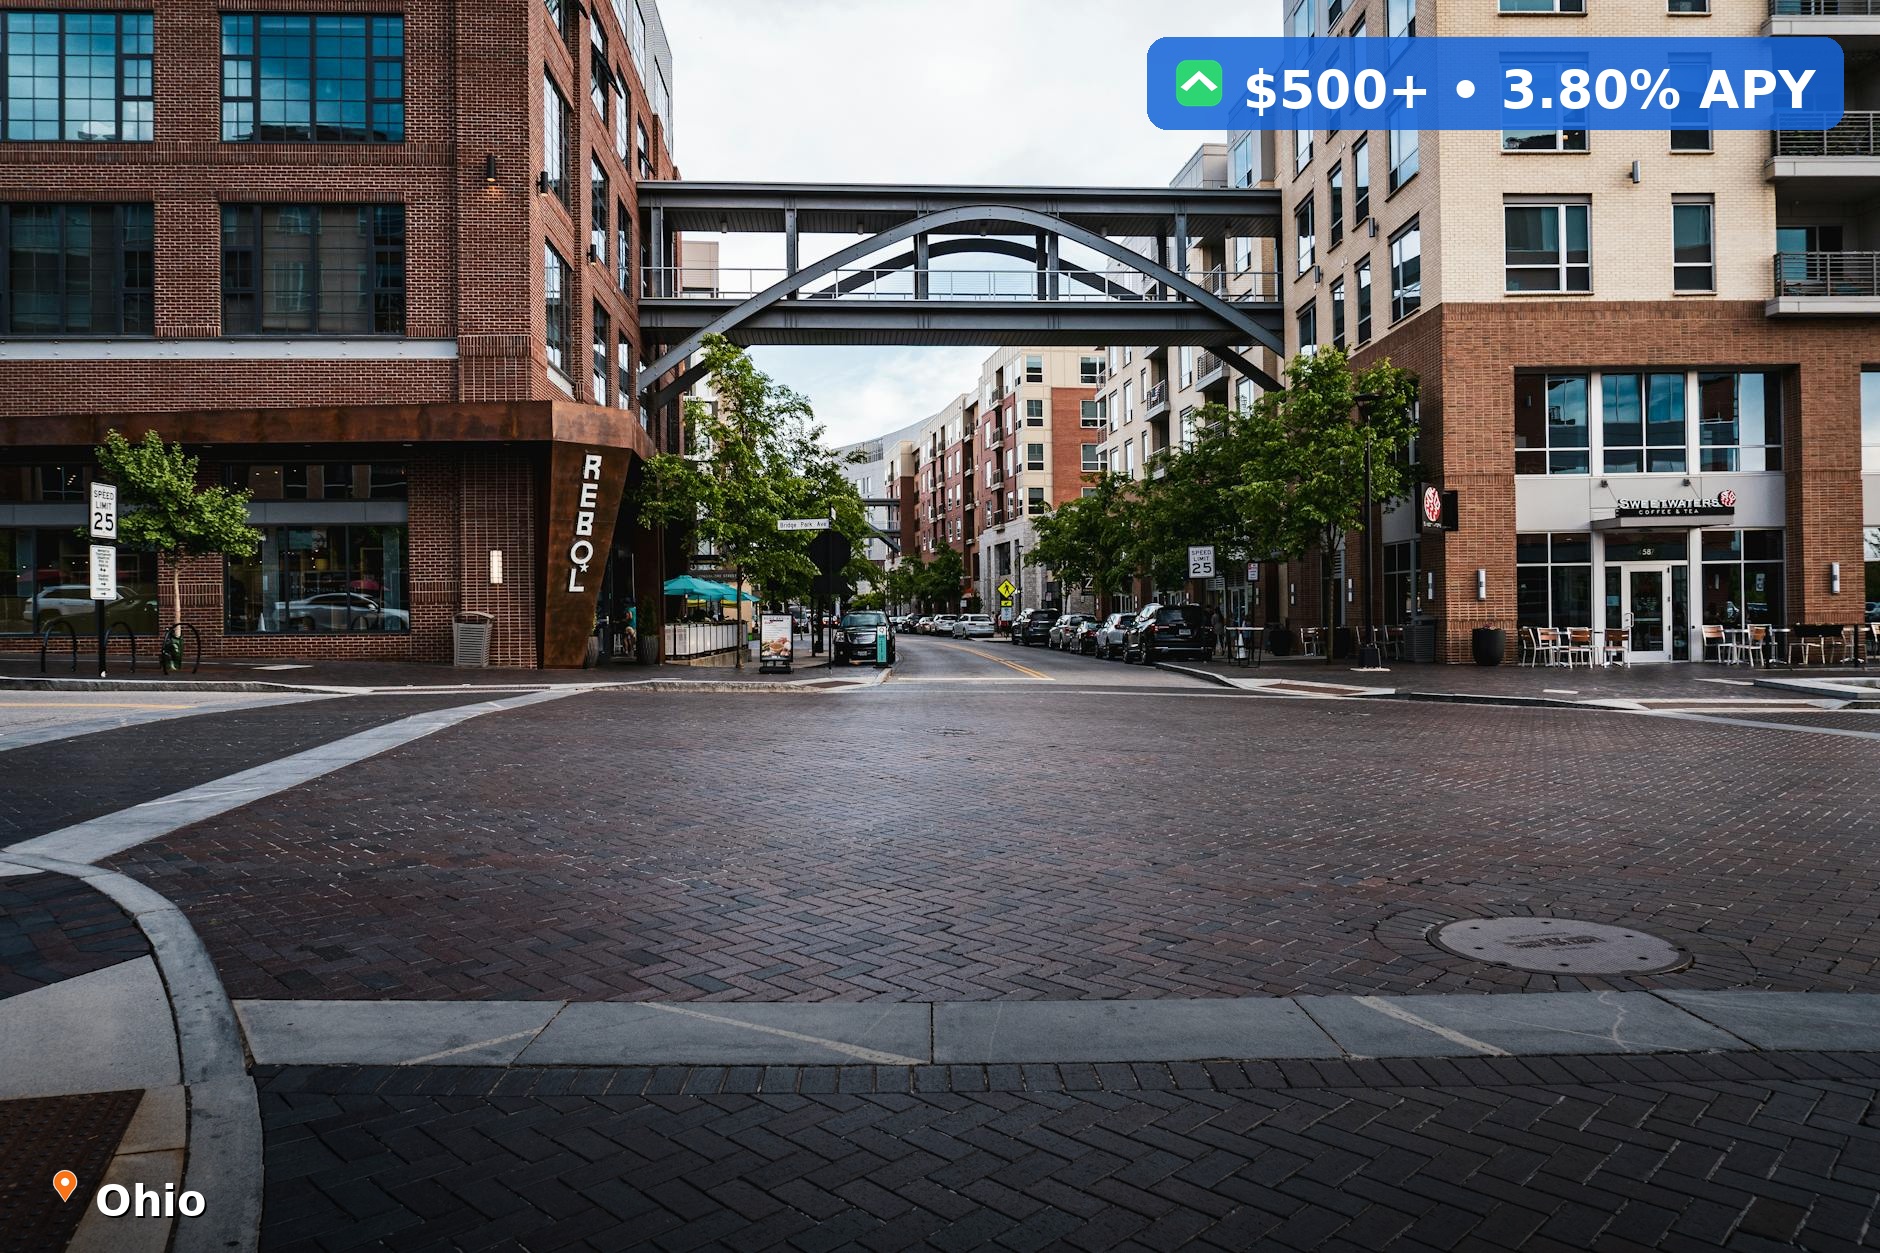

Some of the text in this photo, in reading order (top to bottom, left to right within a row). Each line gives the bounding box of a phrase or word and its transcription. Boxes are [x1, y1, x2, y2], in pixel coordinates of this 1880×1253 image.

[94, 490, 114, 500] SPEED
[95, 501, 112, 510] LIMIT
[94, 511, 114, 531] 25
[568, 454, 603, 593] REBOL
[1192, 562, 1212, 574] 25
